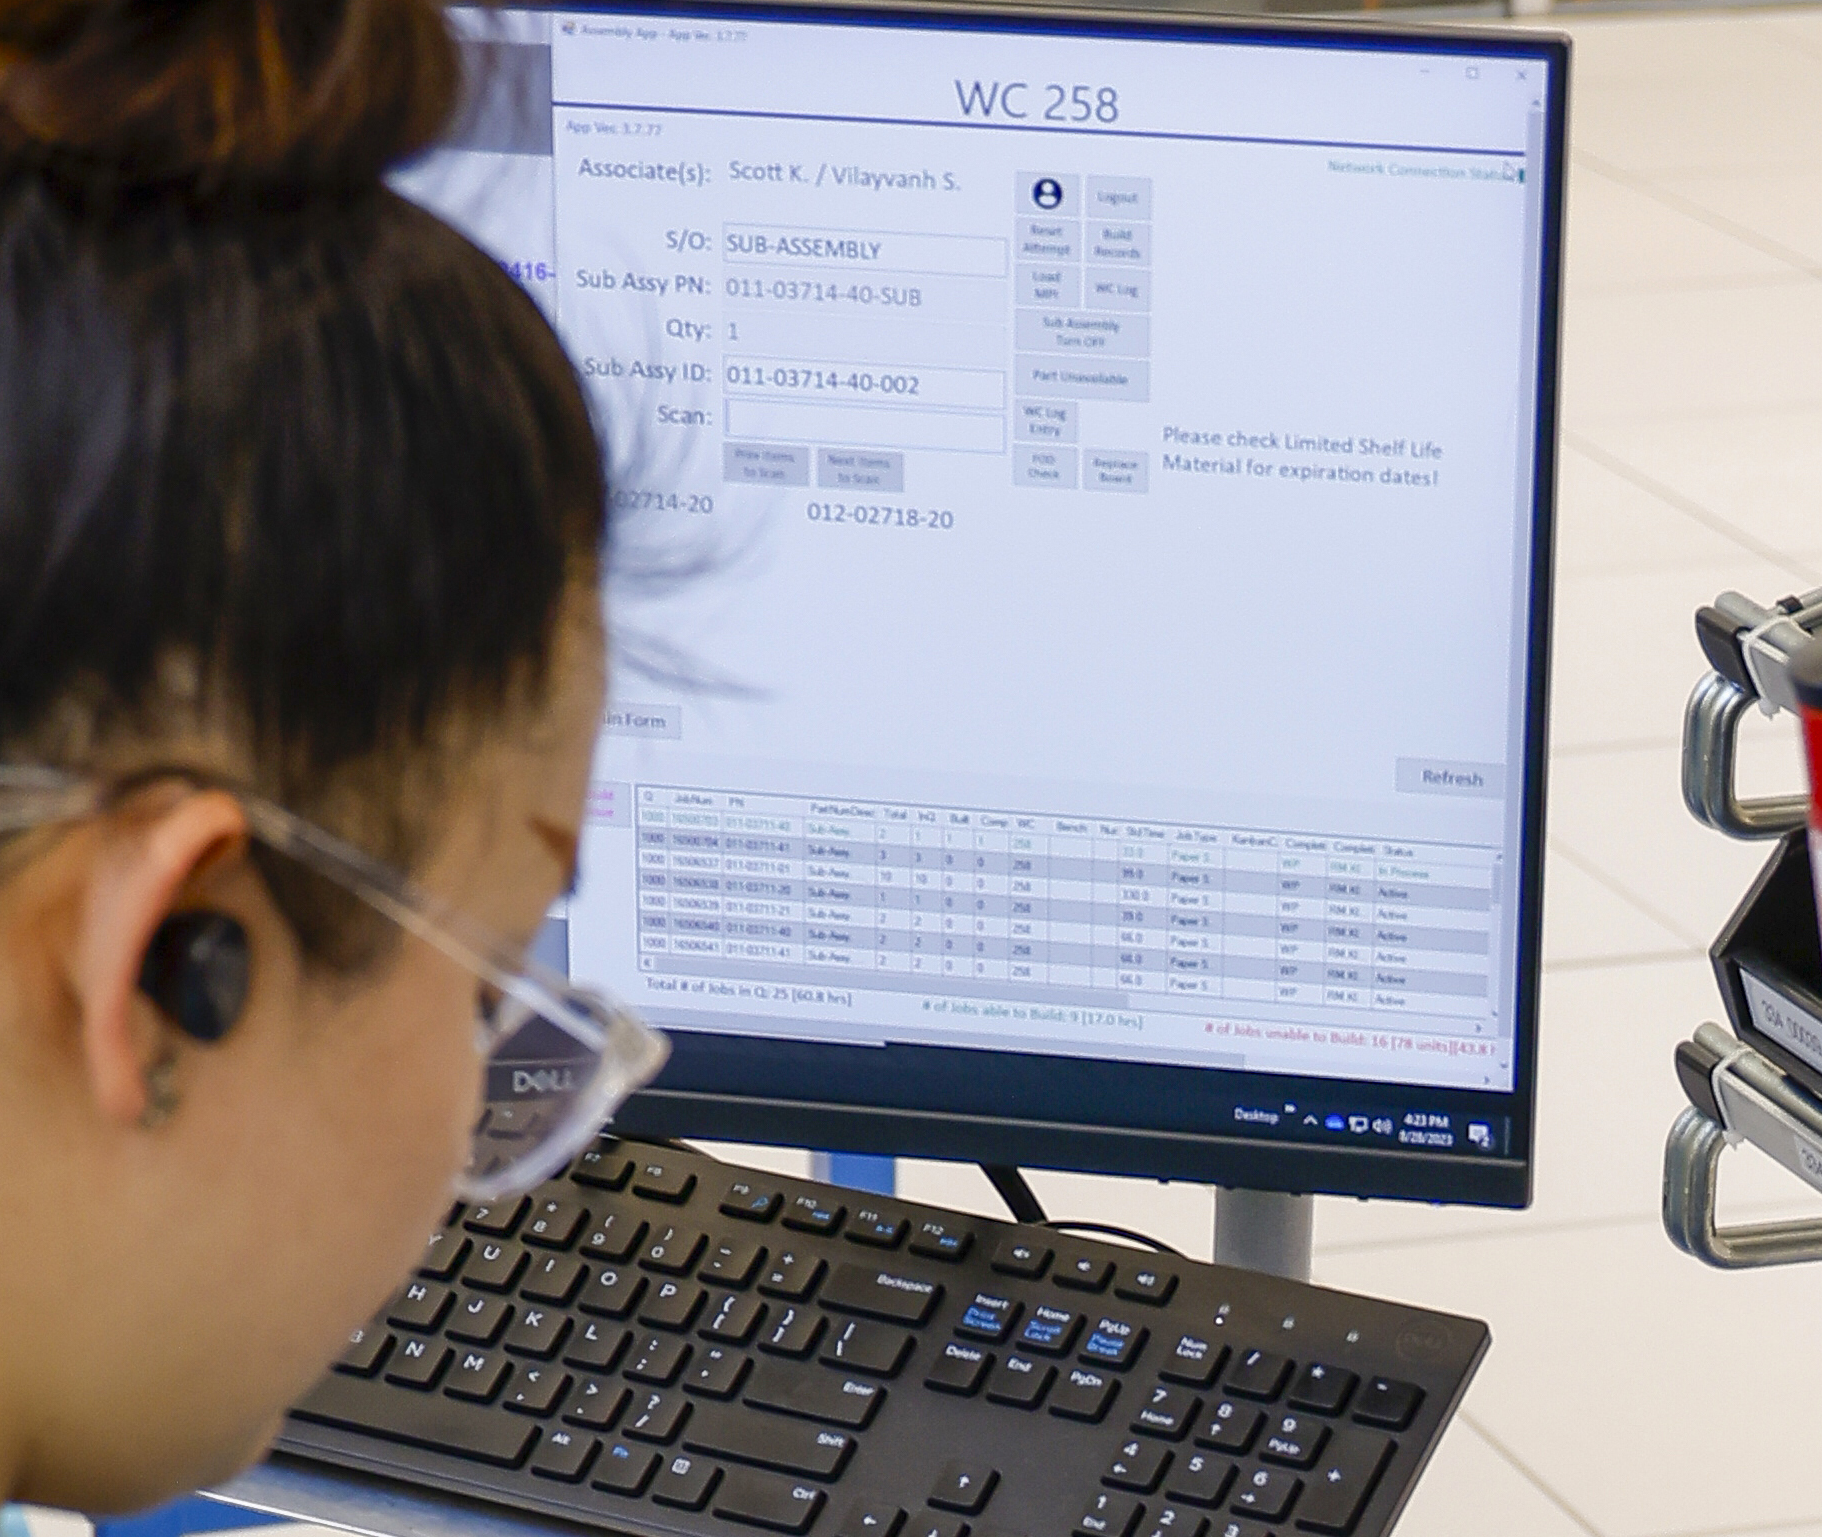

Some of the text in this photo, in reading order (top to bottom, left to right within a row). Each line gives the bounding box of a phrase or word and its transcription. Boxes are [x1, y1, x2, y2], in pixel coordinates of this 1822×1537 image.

[954, 79, 1120, 123] WC 258
[565, 119, 589, 135] App
[578, 157, 962, 193] Associate(s): Scott K. / Vilayvanh S.
[665, 230, 882, 260] S/O: SUB-ASSEMBLY
[576, 270, 922, 308] Sub Assy PN: 011-03714-40-SUB
[666, 318, 739, 342] Qty: 1
[583, 356, 920, 396] Sub Assy ID: 011-03714-40-002
[656, 404, 713, 427] Scan:
[1162, 425, 1442, 460] Please check Limited Shelf Life
[1162, 453, 1439, 487] Material for expiration dates!
[806, 501, 955, 531] 012-02718-20
[1422, 768, 1485, 788] Refresh
[1233, 1106, 1279, 1125] Desktop
[592, 1231, 606, 1245] 9
[483, 1244, 501, 1260] U
[600, 1270, 618, 1286] O
[877, 1272, 934, 1294] Backspace
[407, 1284, 427, 1301] H
[659, 1282, 677, 1297] P
[467, 1299, 484, 1314] J
[975, 1293, 1010, 1311] Insert
[525, 1311, 543, 1327] K
[1036, 1306, 1071, 1323] Home
[584, 1324, 598, 1341] L
[1098, 1317, 1132, 1336] PgUp
[405, 1341, 425, 1358] N
[1180, 1335, 1208, 1351] Num
[945, 1343, 982, 1361] Delete
[1176, 1345, 1203, 1360] Lock
[463, 1353, 485, 1371] M
[1006, 1357, 1033, 1373] End
[1070, 1369, 1103, 1388] PgDn
[843, 1379, 875, 1396] Enter
[1152, 1387, 1168, 1403] 7
[1140, 1409, 1175, 1427] Home
[1216, 1403, 1232, 1419] 8
[1282, 1417, 1297, 1433] 9
[551, 1432, 571, 1445] Alt
[816, 1432, 845, 1449] Shift
[1123, 1441, 1139, 1457] 4
[1188, 1455, 1204, 1472] 5
[1252, 1470, 1269, 1487] 6
[792, 1486, 817, 1500] Ctrl
[1159, 1509, 1176, 1525] 2
